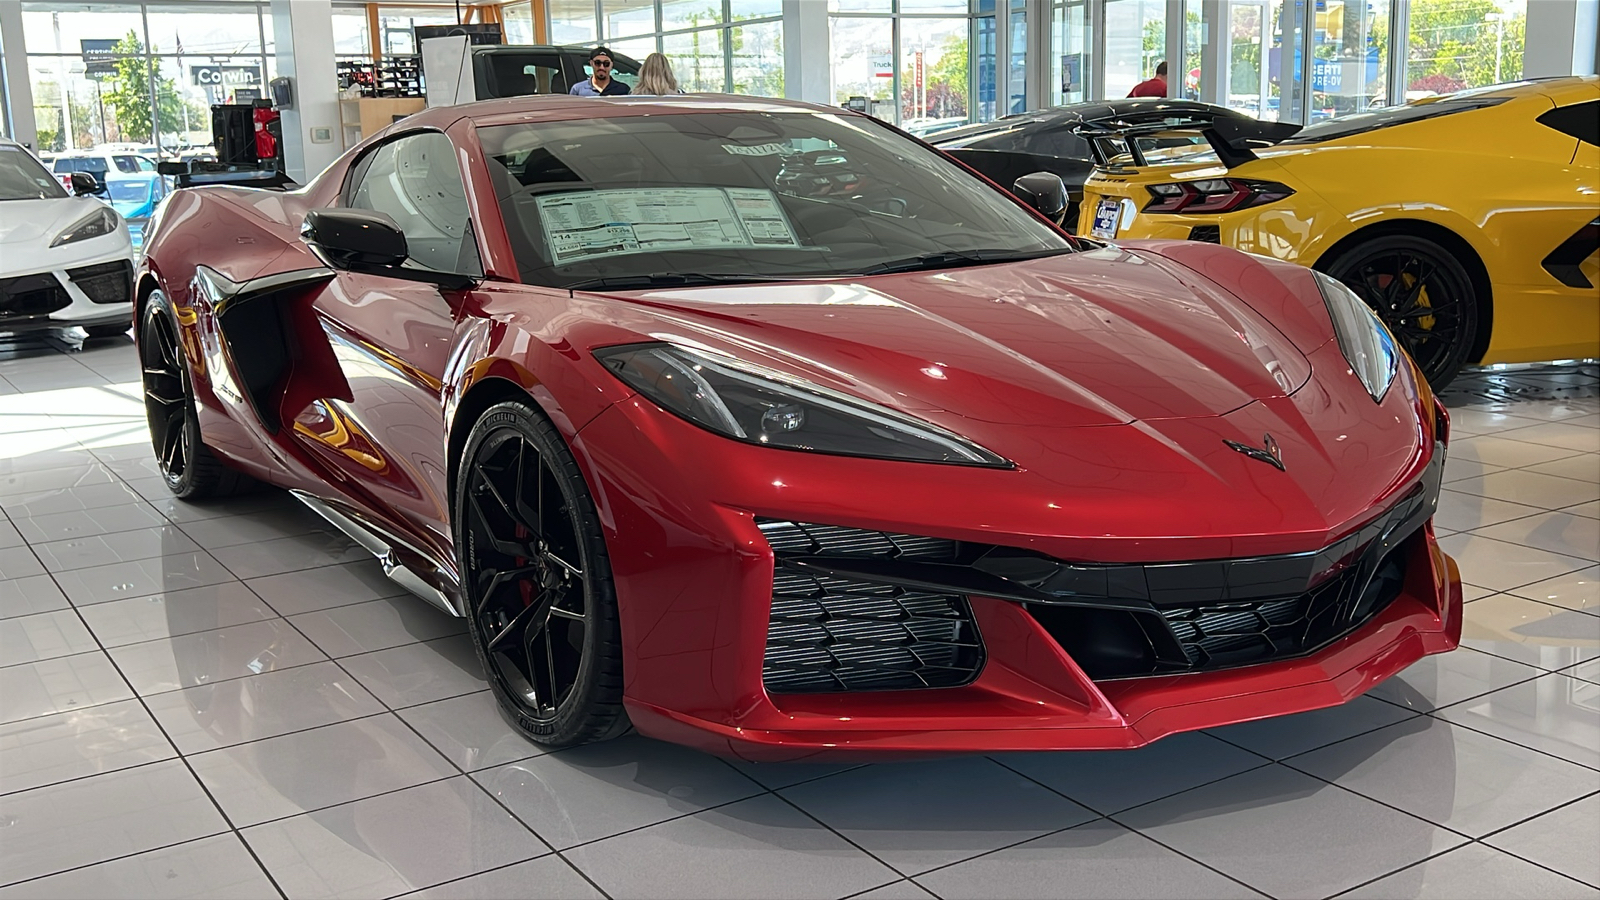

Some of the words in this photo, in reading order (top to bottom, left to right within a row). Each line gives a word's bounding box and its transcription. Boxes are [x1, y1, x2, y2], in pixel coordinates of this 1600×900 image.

[198, 67, 254, 84] Corwin
[558, 233, 572, 241] 14
[485, 412, 516, 427] MICHELIN
